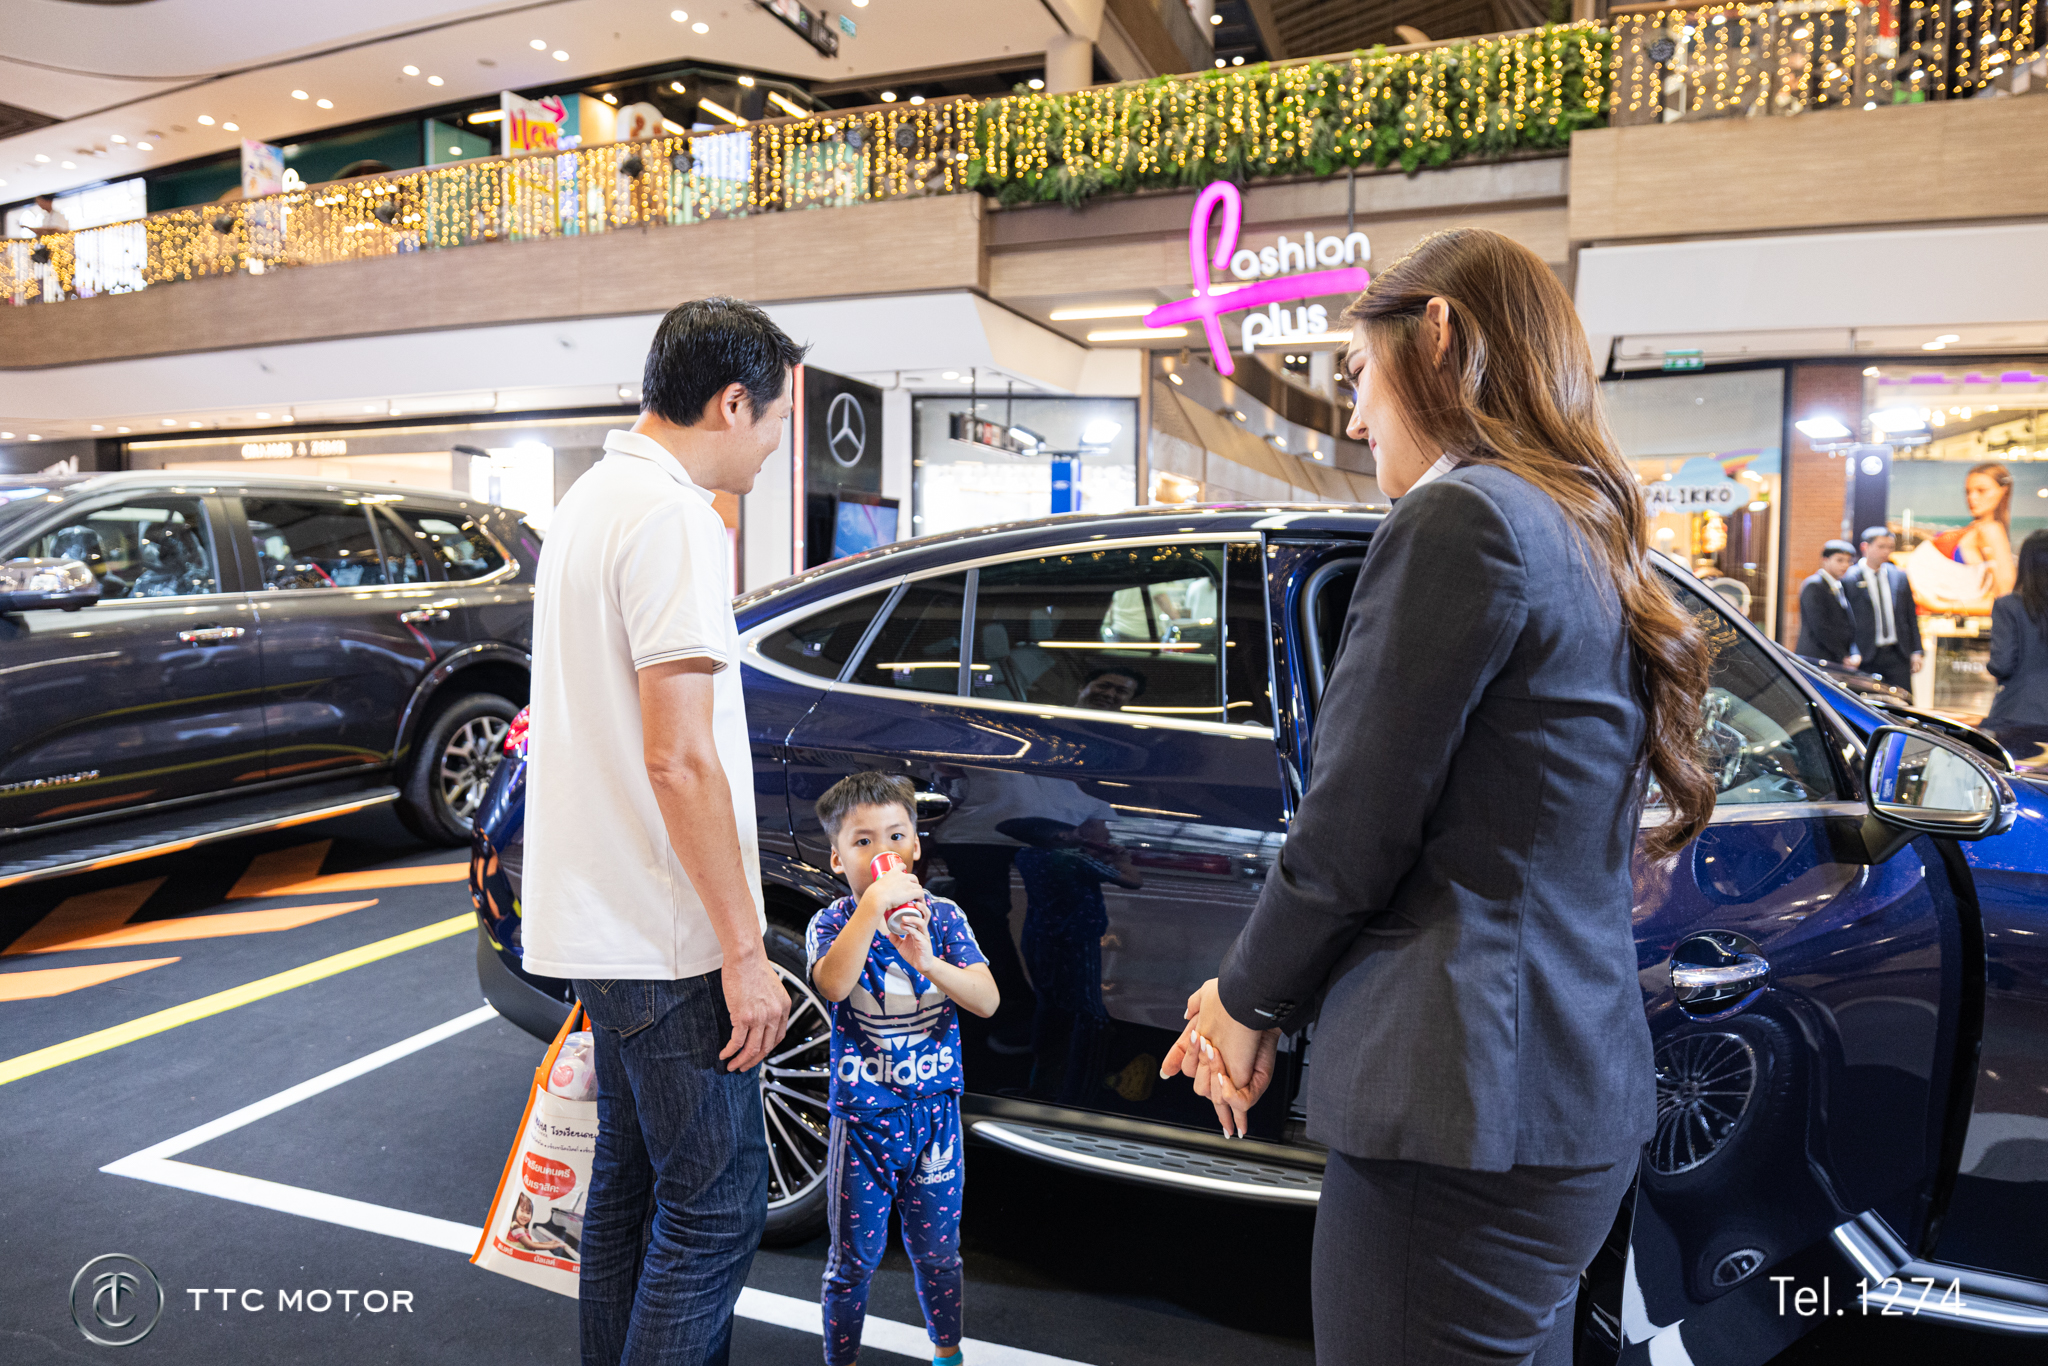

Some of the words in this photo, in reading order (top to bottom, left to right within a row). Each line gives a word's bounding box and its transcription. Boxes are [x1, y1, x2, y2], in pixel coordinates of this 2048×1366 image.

[1241, 302, 1329, 354] plus
[837, 1046, 954, 1086] adidas
[915, 1168, 956, 1185] adidas
